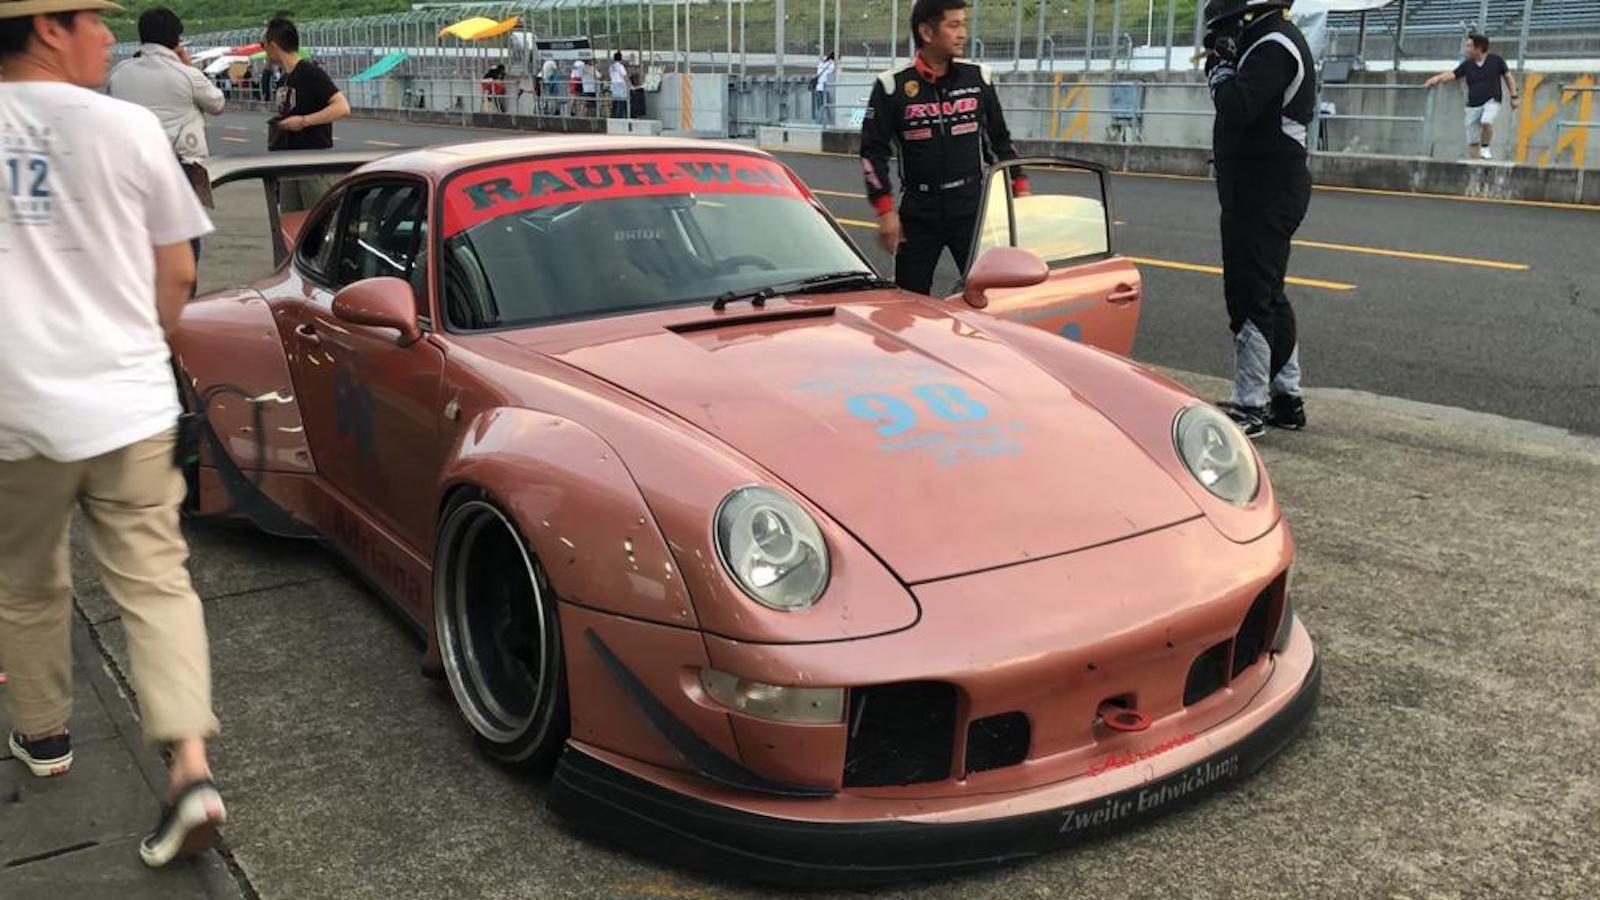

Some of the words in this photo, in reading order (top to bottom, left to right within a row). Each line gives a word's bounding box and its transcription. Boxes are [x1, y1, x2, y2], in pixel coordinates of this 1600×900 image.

[905, 97, 978, 120] RWB
[6, 158, 51, 198] 12
[463, 159, 796, 212] RAUH-Wel
[845, 383, 990, 437] 98
[1059, 799, 1133, 834] Zweite
[1136, 753, 1240, 809] Entwicklung
